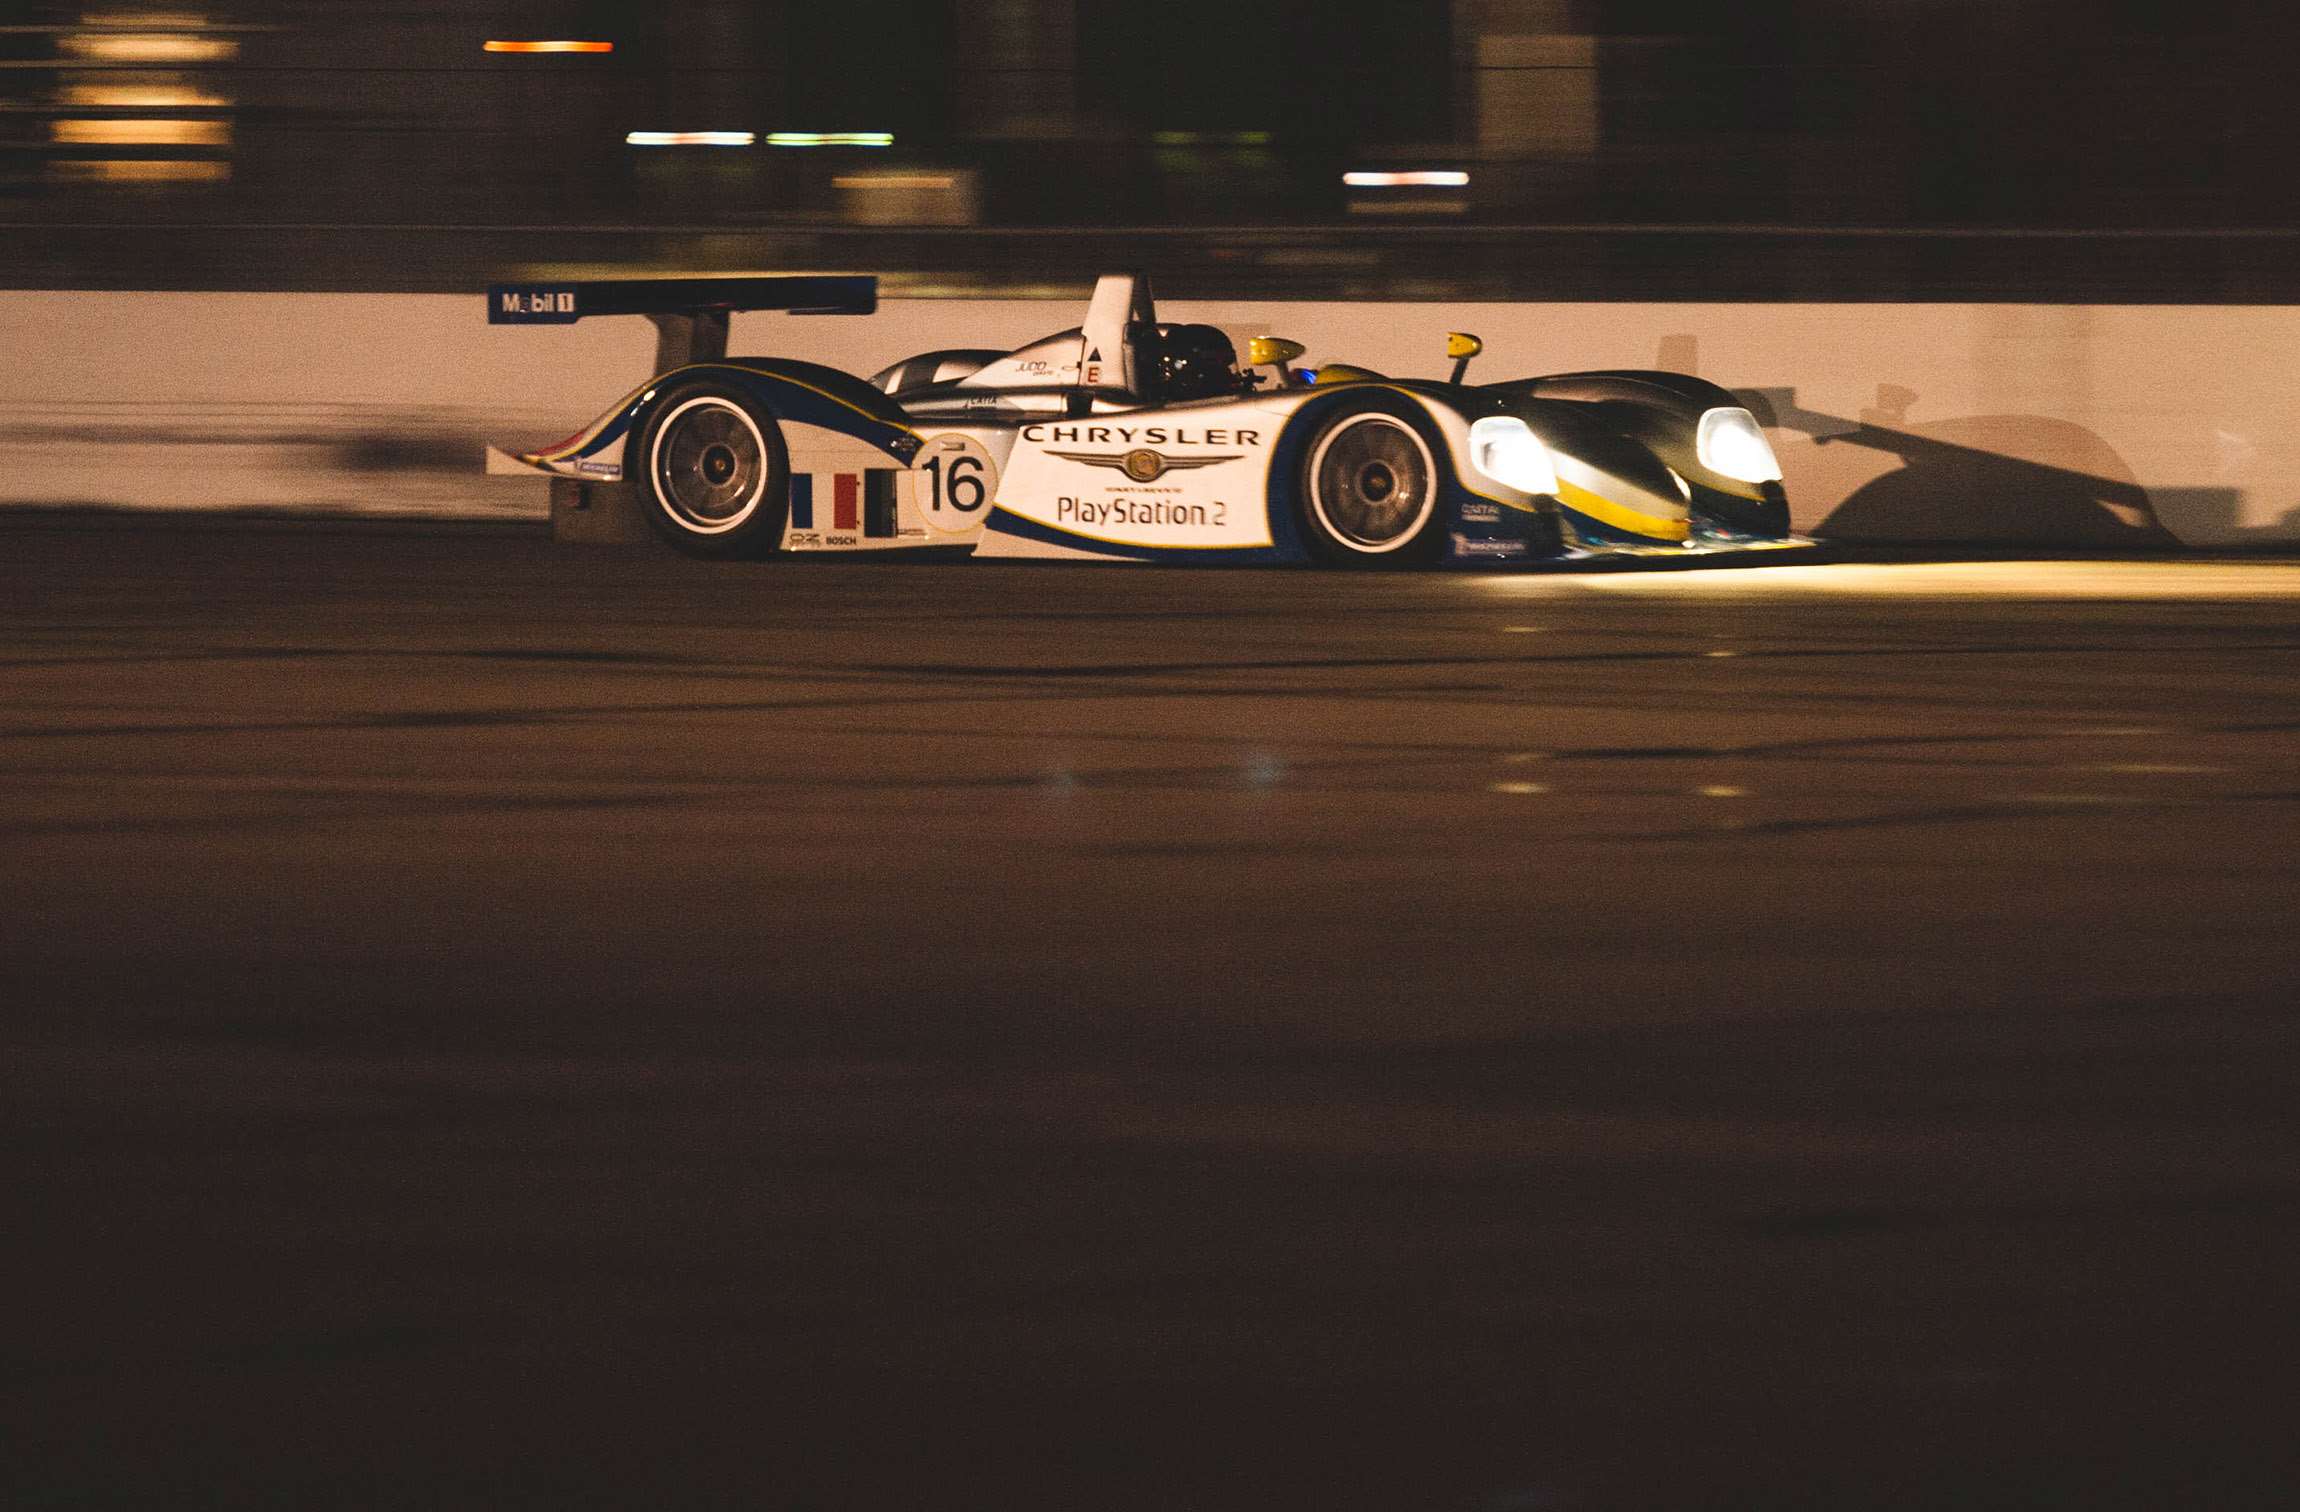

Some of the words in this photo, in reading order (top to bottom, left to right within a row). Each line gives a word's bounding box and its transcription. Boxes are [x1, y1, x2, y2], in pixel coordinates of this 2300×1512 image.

[502, 292, 554, 312] Mobil
[1087, 366, 1101, 383] E
[1022, 425, 1260, 446] CHRYSLER
[921, 455, 986, 513] 16
[1057, 496, 1206, 526] PlayStation
[1213, 501, 1227, 526] 2
[825, 535, 857, 546] BOSCH
